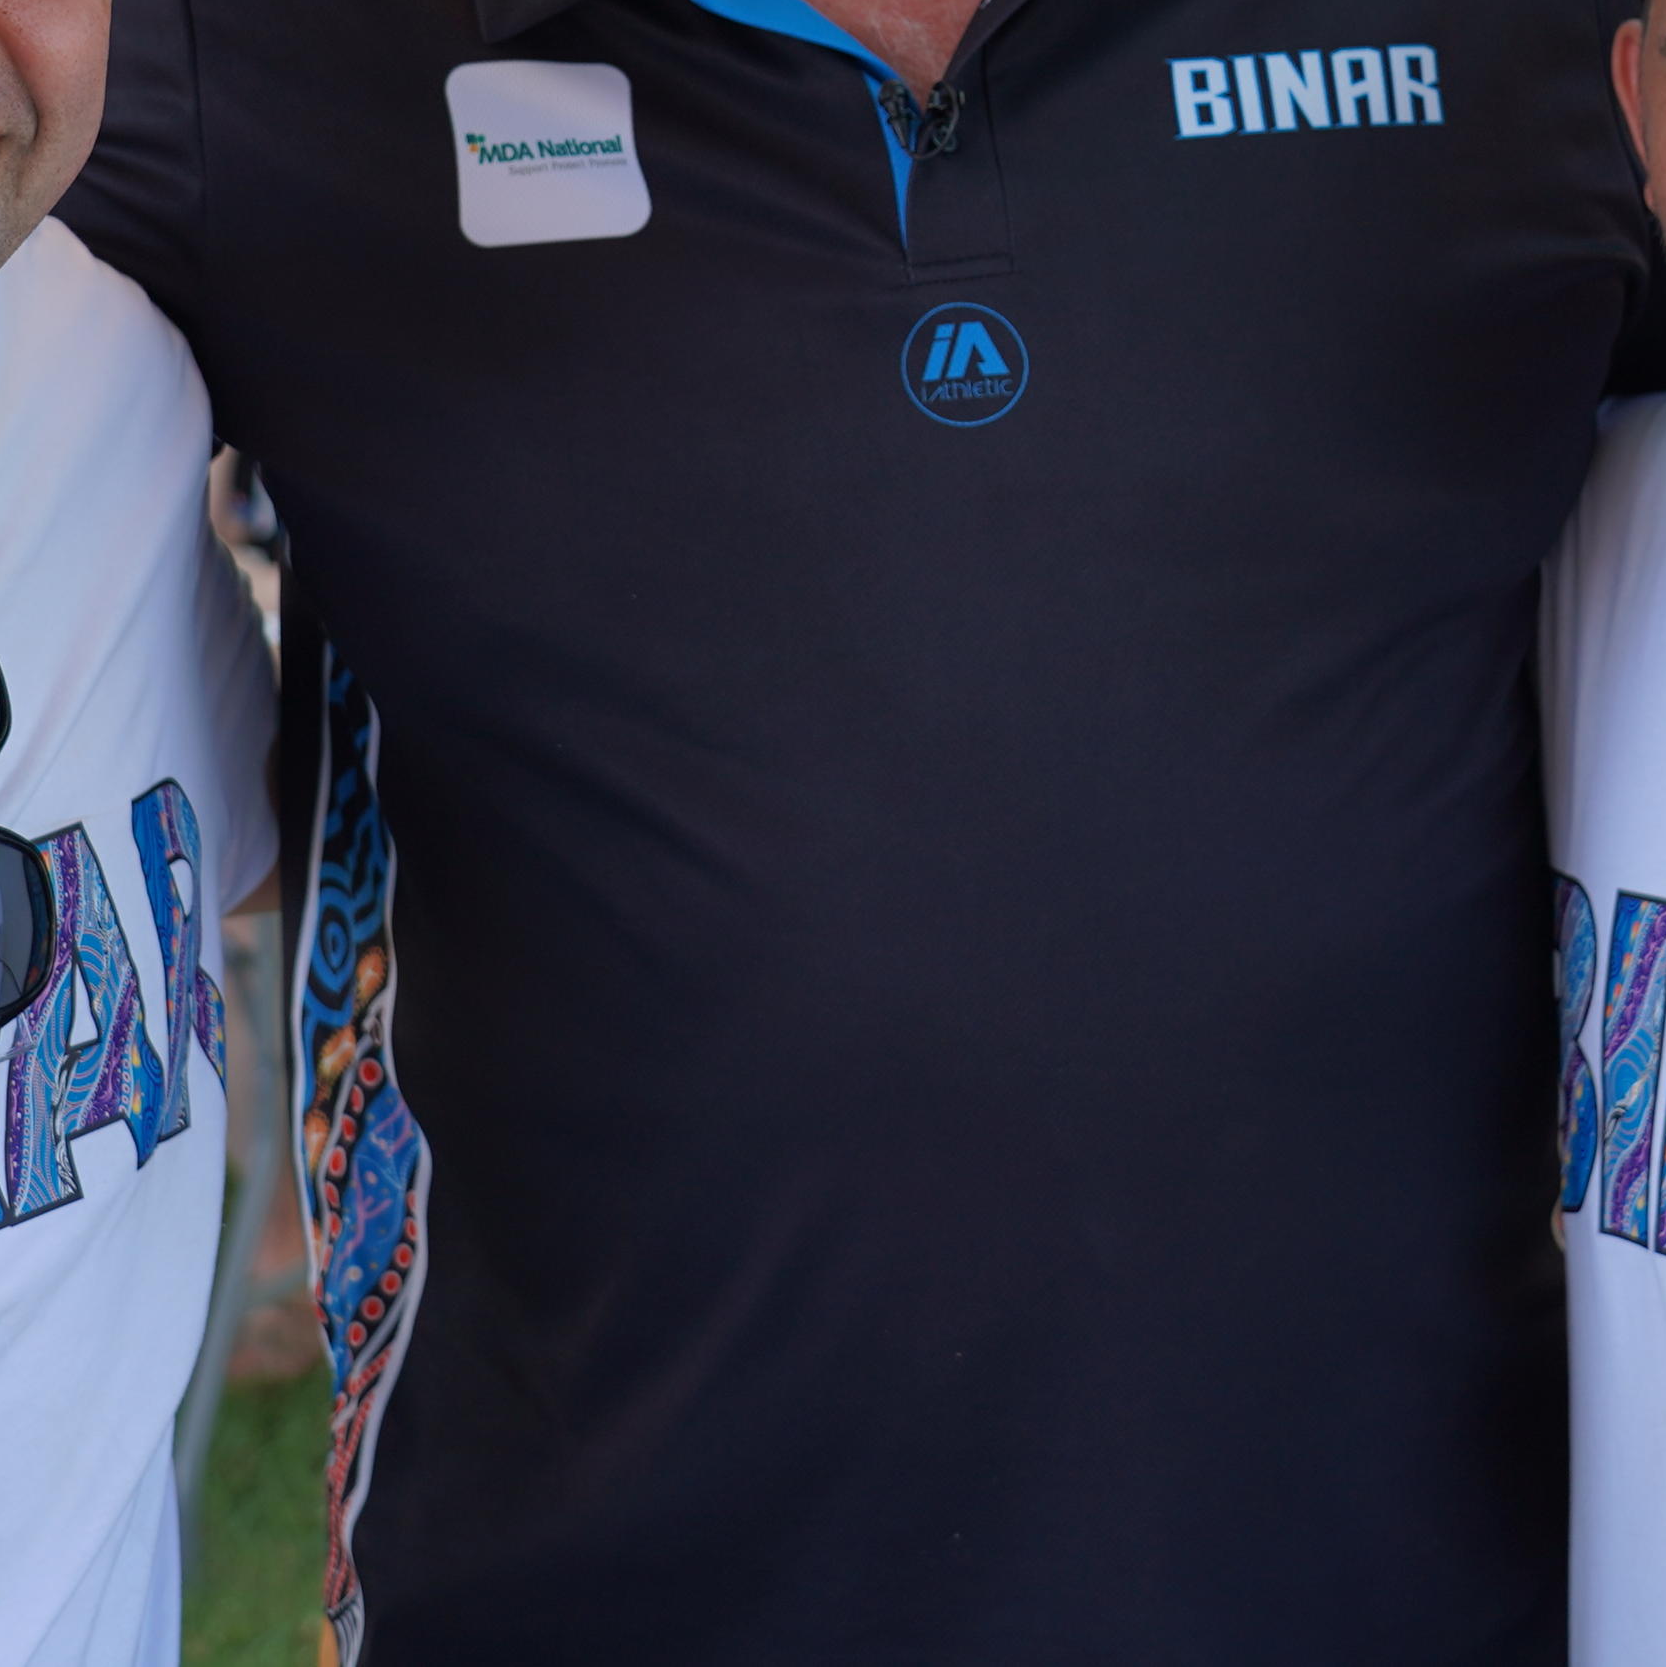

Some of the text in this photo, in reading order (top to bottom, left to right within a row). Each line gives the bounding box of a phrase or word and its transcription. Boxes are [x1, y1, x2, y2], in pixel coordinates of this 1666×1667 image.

[1167, 43, 1446, 140] BINAR
[479, 134, 623, 165] MDA National
